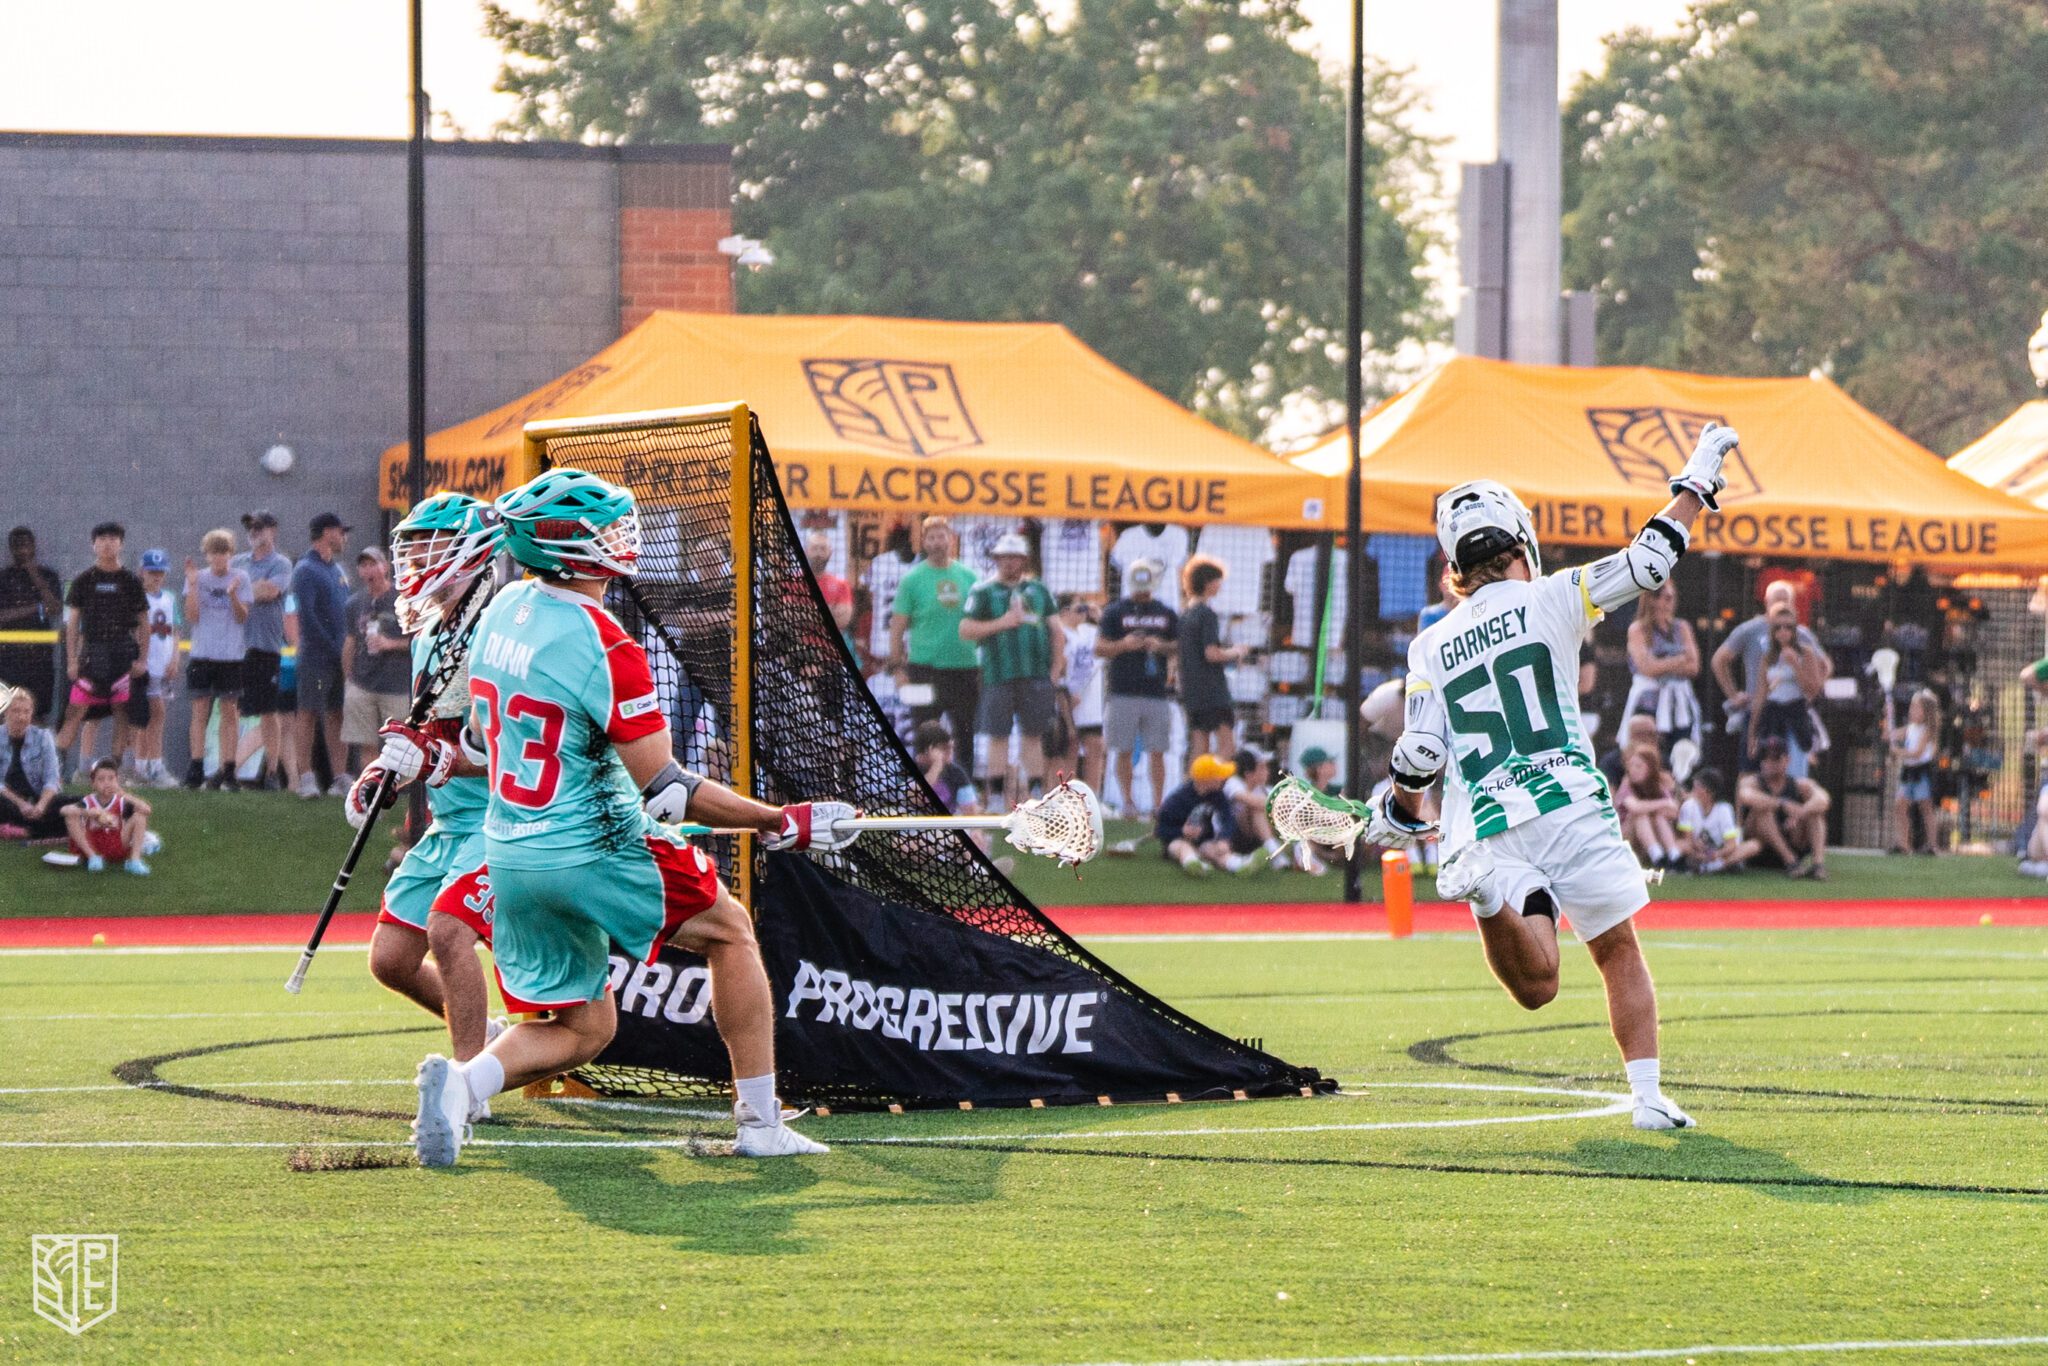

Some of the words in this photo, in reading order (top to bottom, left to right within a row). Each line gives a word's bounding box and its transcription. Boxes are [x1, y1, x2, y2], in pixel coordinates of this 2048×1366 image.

[829, 464, 1047, 508] LACROSSE
[1065, 473, 1227, 515] LEAGUE
[1622, 504, 1830, 551] LROSSE
[1846, 517, 1999, 556] LEAGUE
[1643, 561, 1664, 583] STX
[483, 633, 535, 680] DUNN
[1440, 606, 1527, 672] GARNSEY
[1442, 641, 1569, 784] 50
[439, 751, 453, 776] STX
[469, 677, 566, 811] 33
[1414, 744, 1440, 762] STX
[785, 959, 1099, 1055] PROGRESSIVE
